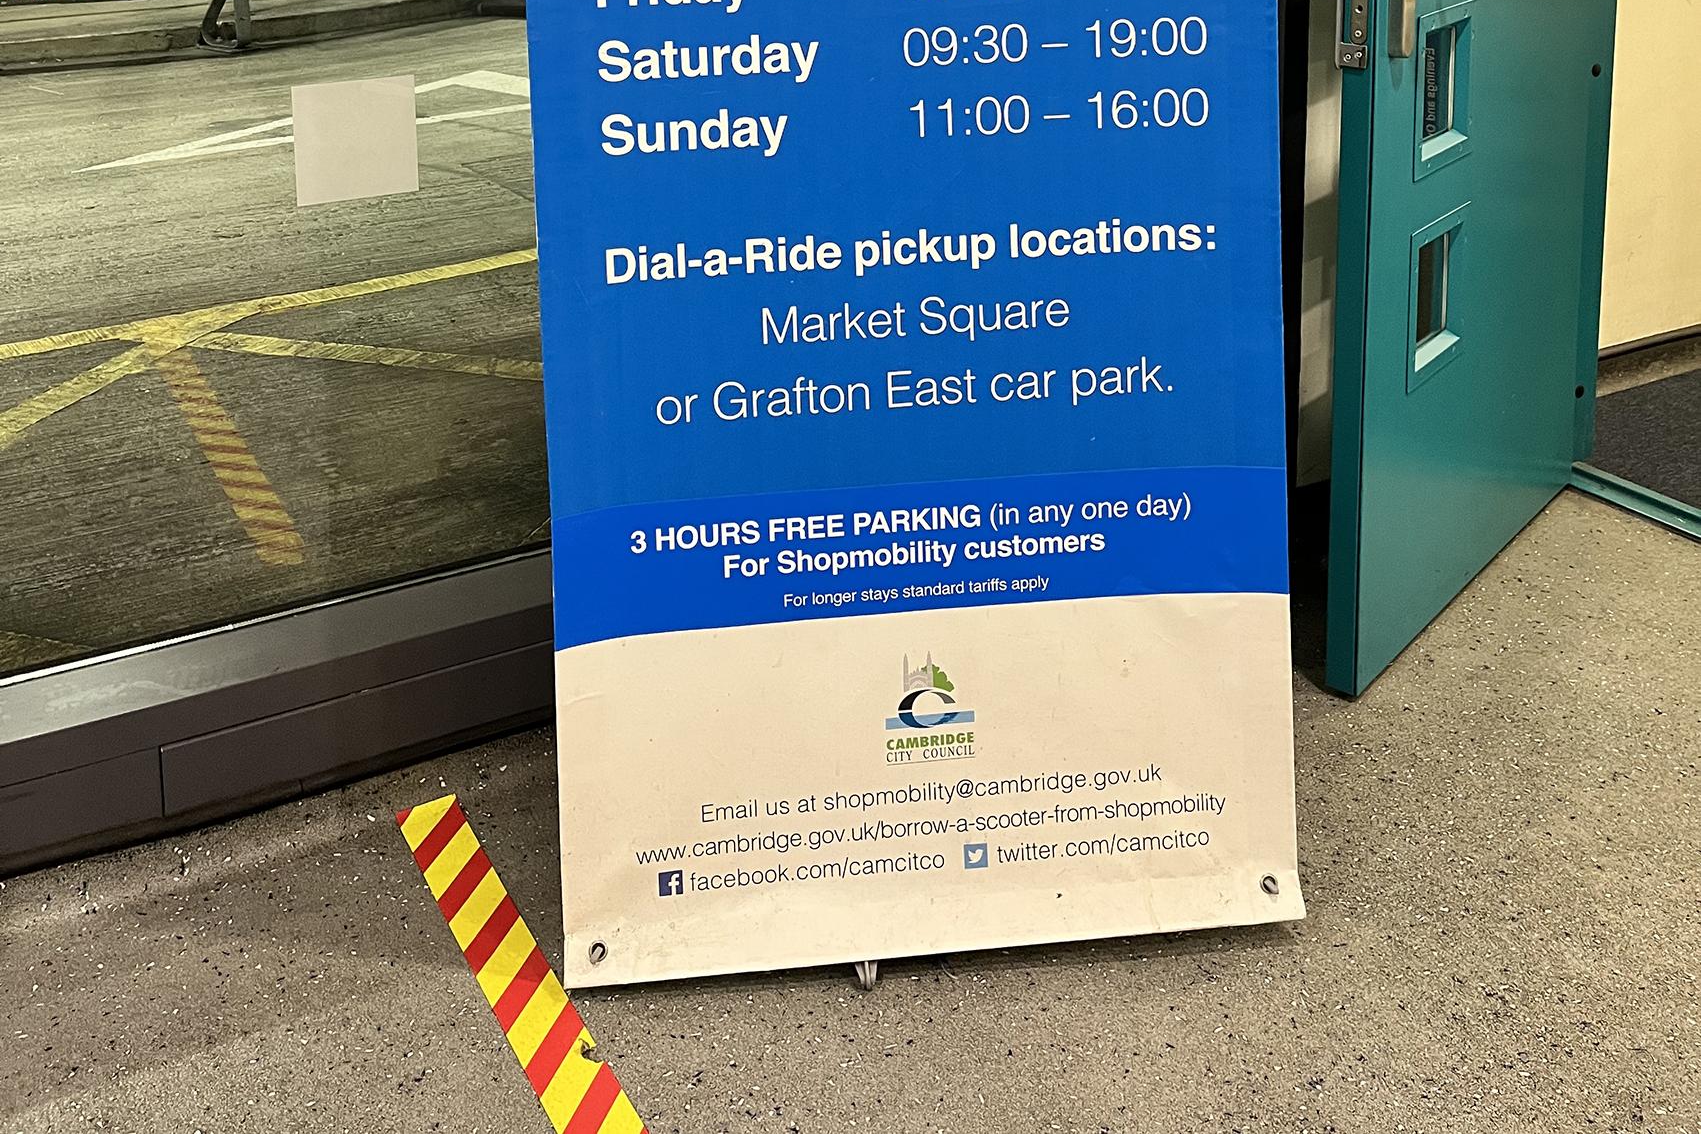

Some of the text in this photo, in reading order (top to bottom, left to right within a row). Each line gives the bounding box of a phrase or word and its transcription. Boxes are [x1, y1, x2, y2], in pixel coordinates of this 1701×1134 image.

[599, 35, 818, 82] Saturday
[904, 24, 1027, 66] 09:30
[1086, 17, 1206, 57] 19:00
[602, 109, 787, 156] Sunday
[910, 96, 1029, 137] 11:00
[1088, 88, 1208, 128] 16:00
[606, 219, 1215, 284] Dial-a-Ride pickup locations:
[763, 297, 1069, 344] Market Square
[657, 357, 1172, 424] or Grafton East car park.
[631, 493, 1190, 553] 3 HOURS FREE PARKING (in any one day)
[724, 534, 1105, 578] For Shopmobility customers
[784, 576, 1049, 607] For longer stays standard tariffs apply
[887, 732, 974, 750] CAMBRIDGE
[887, 746, 975, 762] CITY COUNCIL
[702, 764, 1161, 822] Email us at shopmobility@cambridge.gov.uk
[636, 794, 1225, 864] www.cambridge.gov.uk/borrow-a-scooter-from-shopmobility
[690, 854, 944, 891] facebook.com/camcitco
[997, 832, 1209, 863] twitter.com/camcitco
